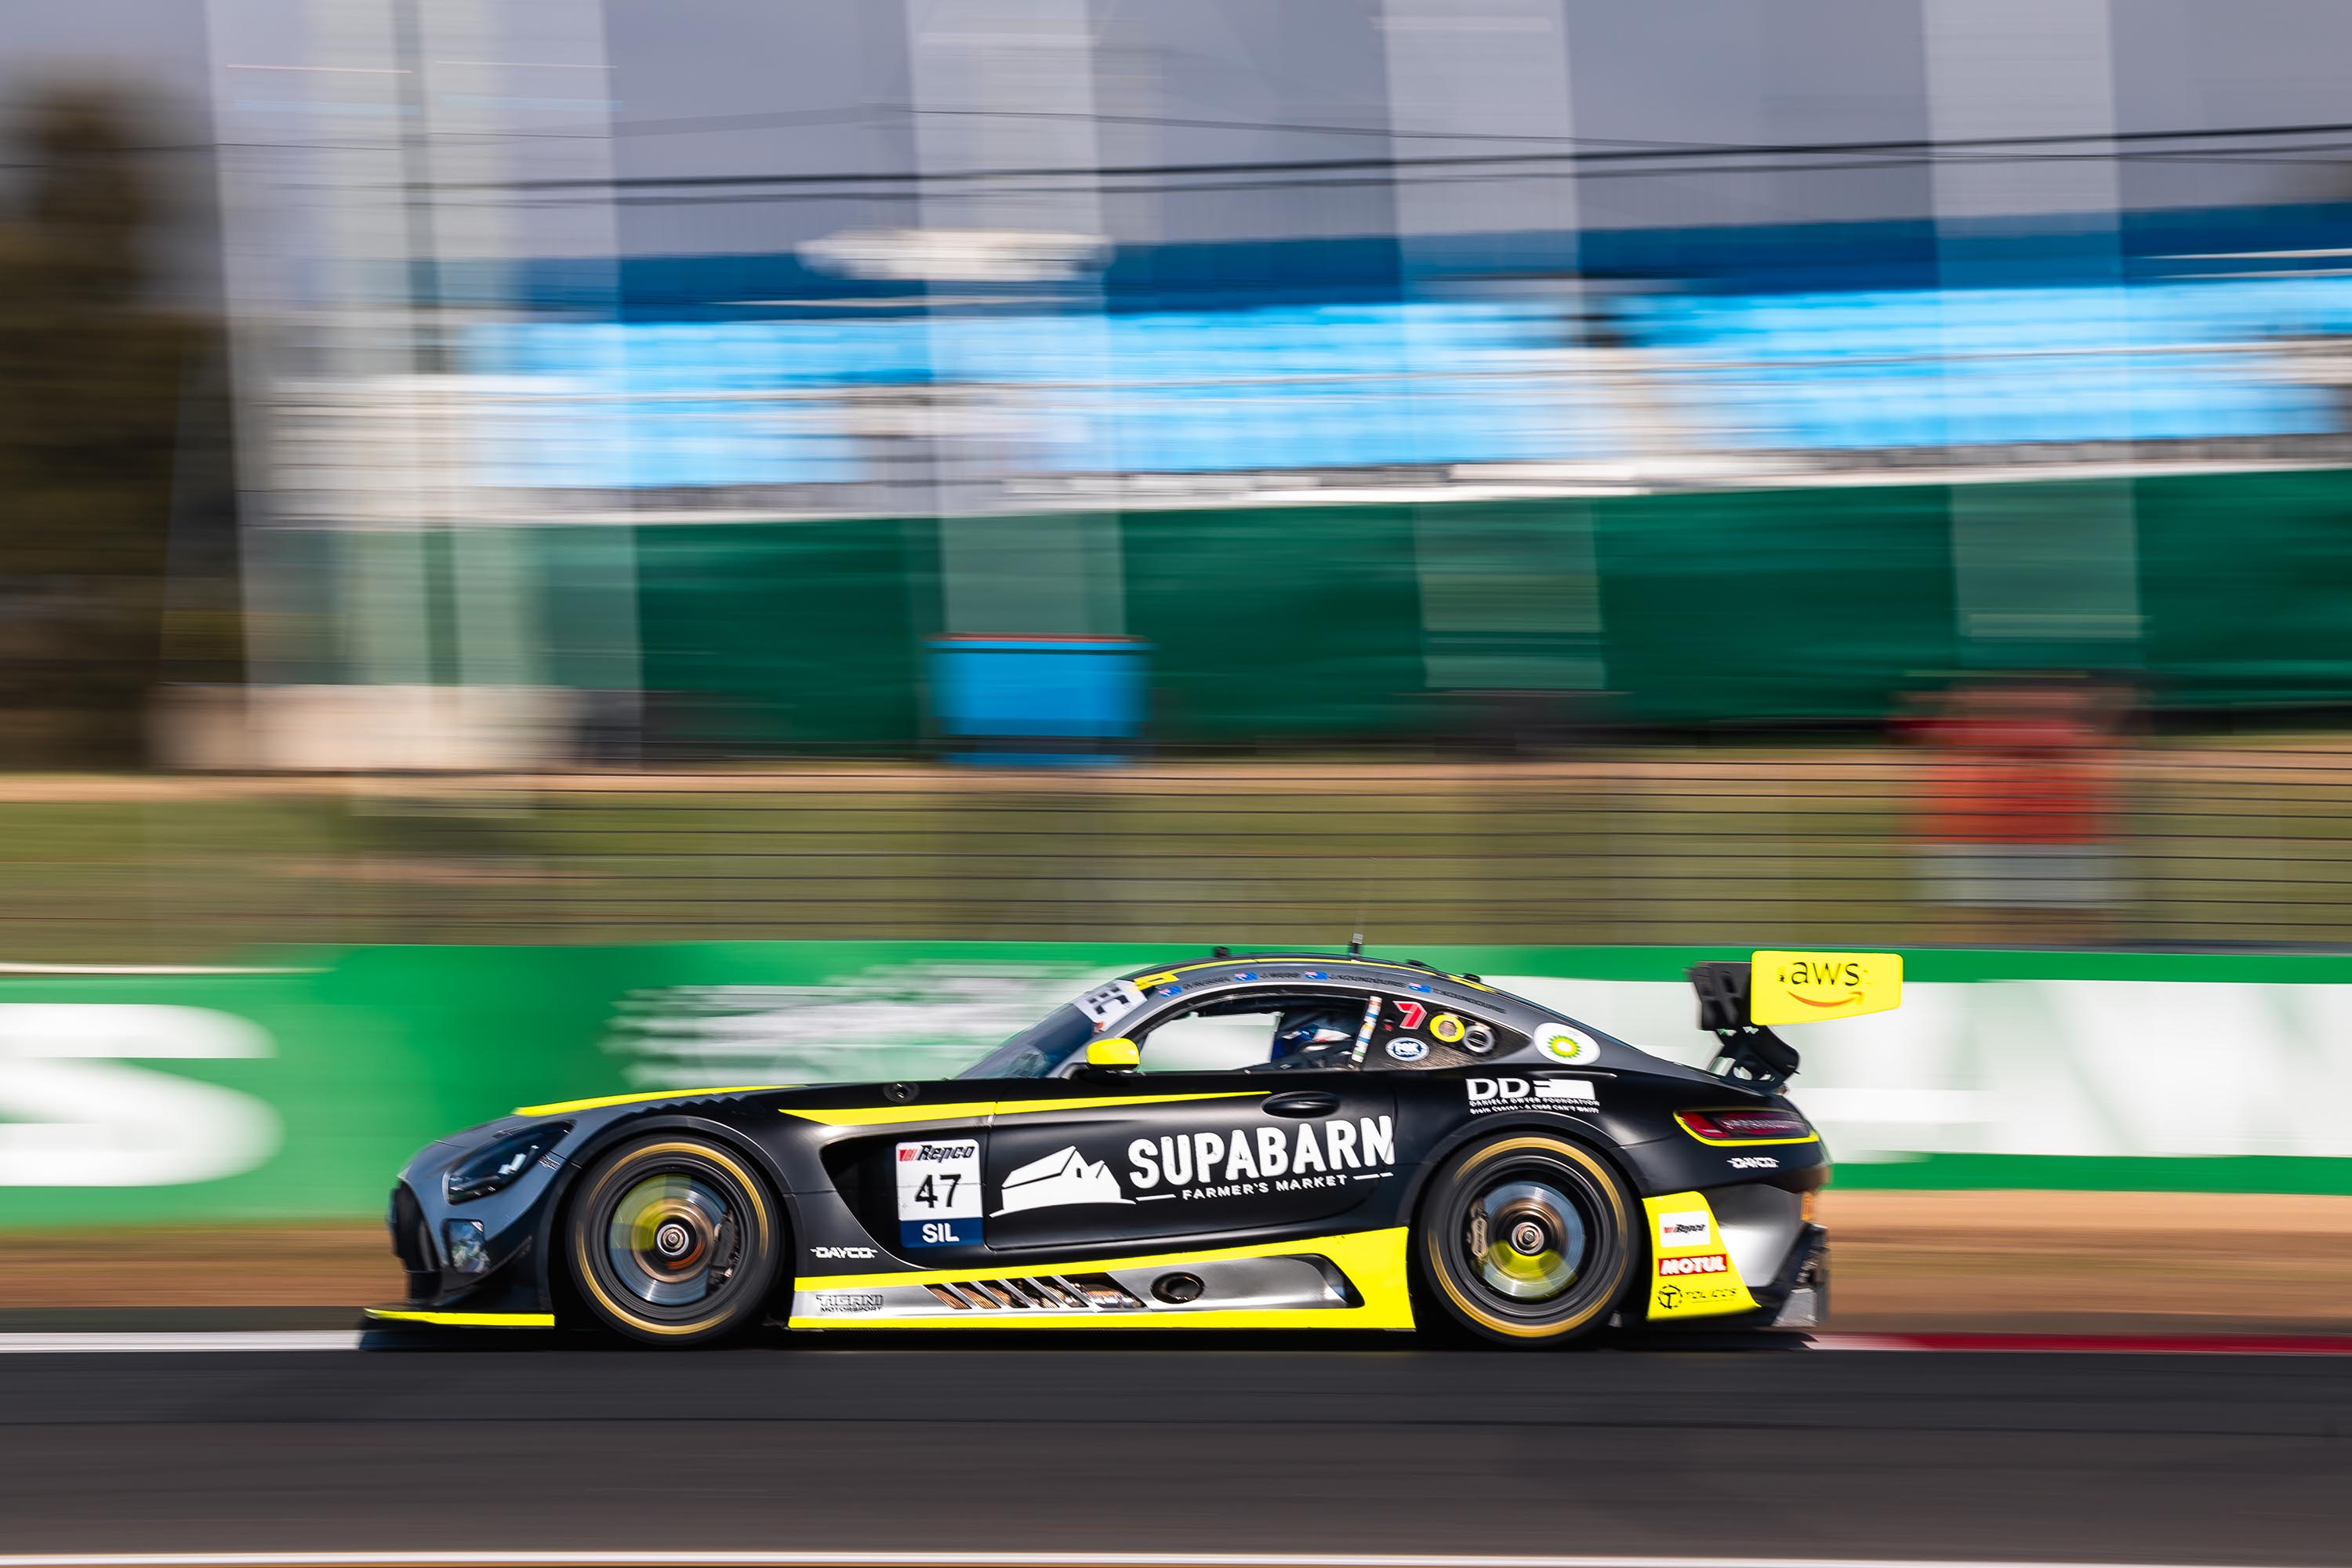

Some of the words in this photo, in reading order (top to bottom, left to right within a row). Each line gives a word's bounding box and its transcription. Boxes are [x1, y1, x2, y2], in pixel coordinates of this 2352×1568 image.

[1791, 961, 1860, 987] aws
[917, 1145, 975, 1163] Repco
[1127, 1115, 1396, 1189] SUPABARN
[915, 1174, 961, 1208] 47
[1182, 1181, 1269, 1200] FARMER'S
[1276, 1174, 1348, 1192] MARKET
[922, 1222, 960, 1243] SIL
[812, 1247, 877, 1259] DAYCO
[1660, 1256, 1727, 1276] MOTUL
